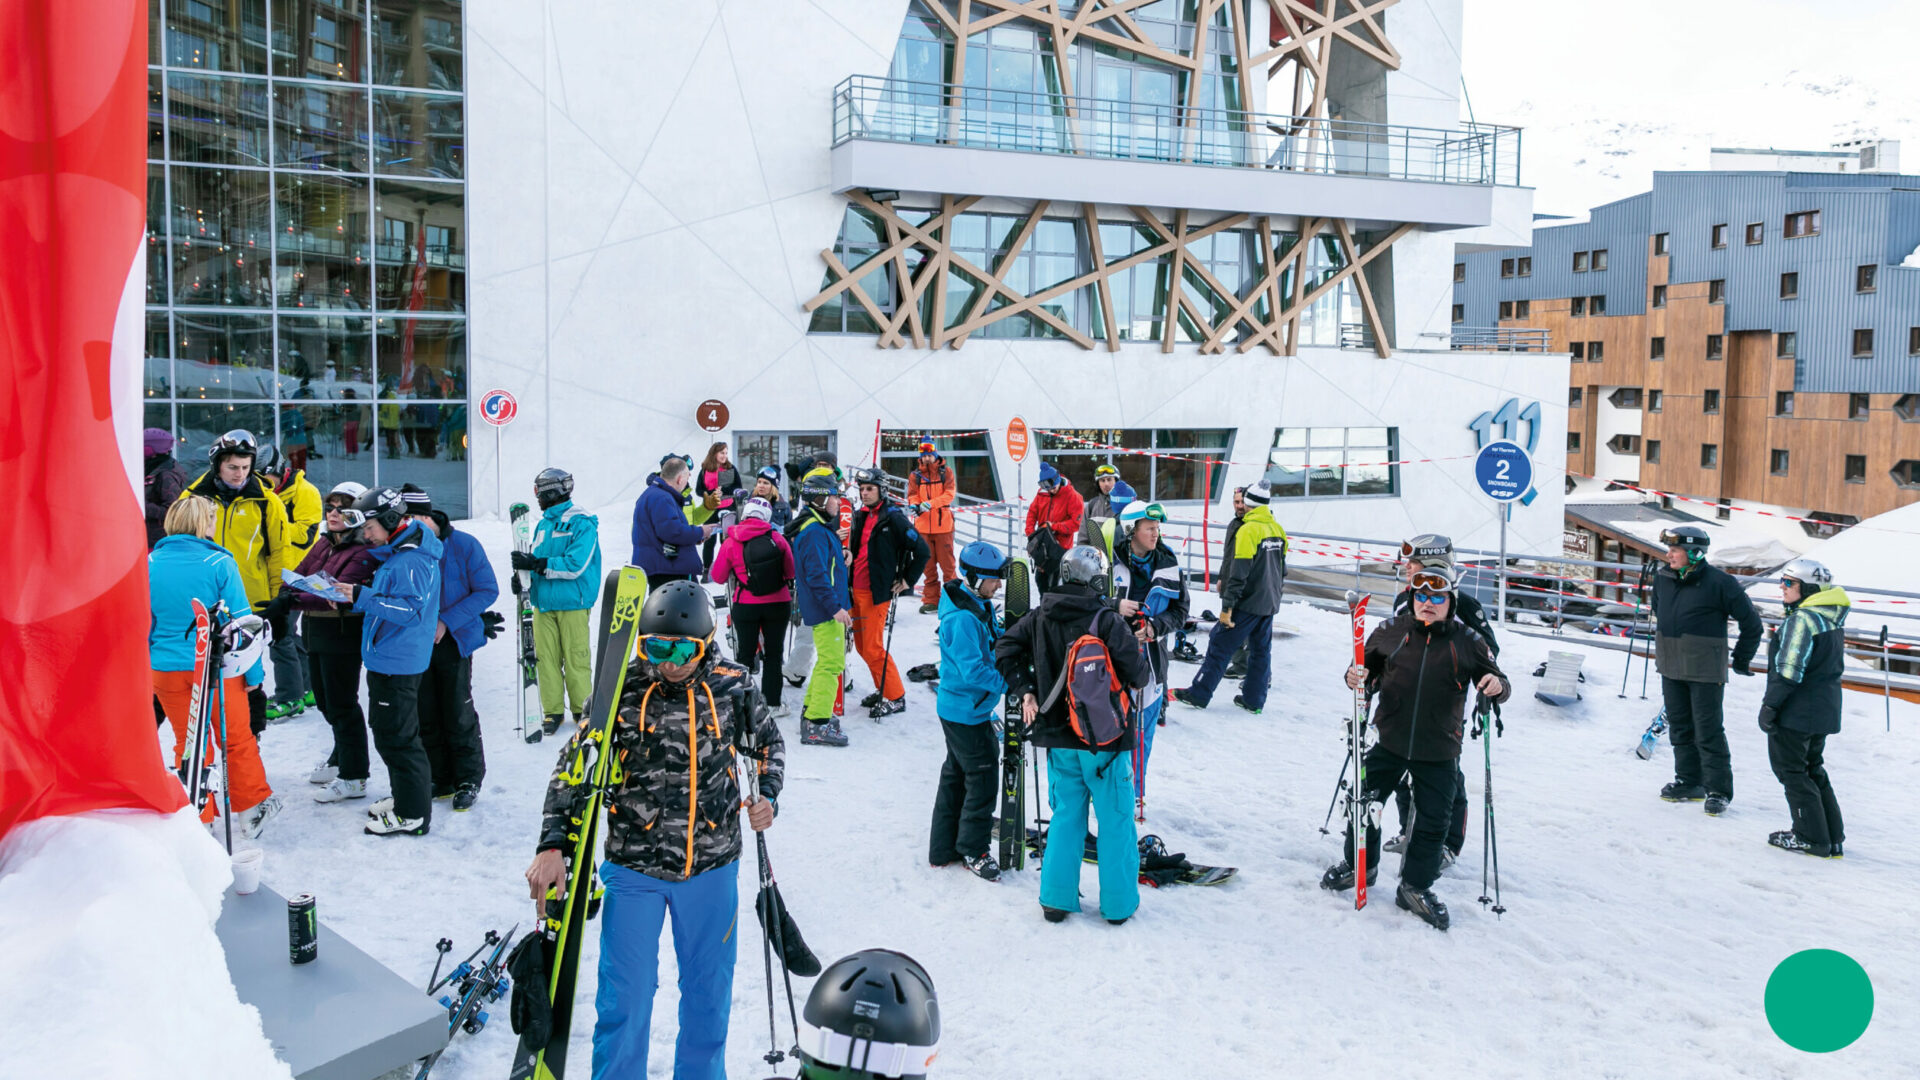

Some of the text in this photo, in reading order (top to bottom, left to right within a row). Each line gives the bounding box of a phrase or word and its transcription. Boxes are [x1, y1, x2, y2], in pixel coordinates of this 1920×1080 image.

[708, 409, 718, 422] 4
[1495, 459, 1510, 480] 2
[1487, 480, 1518, 488] SNOWBOARD
[1420, 547, 1447, 555] uvex
[1811, 567, 1832, 583] 45
